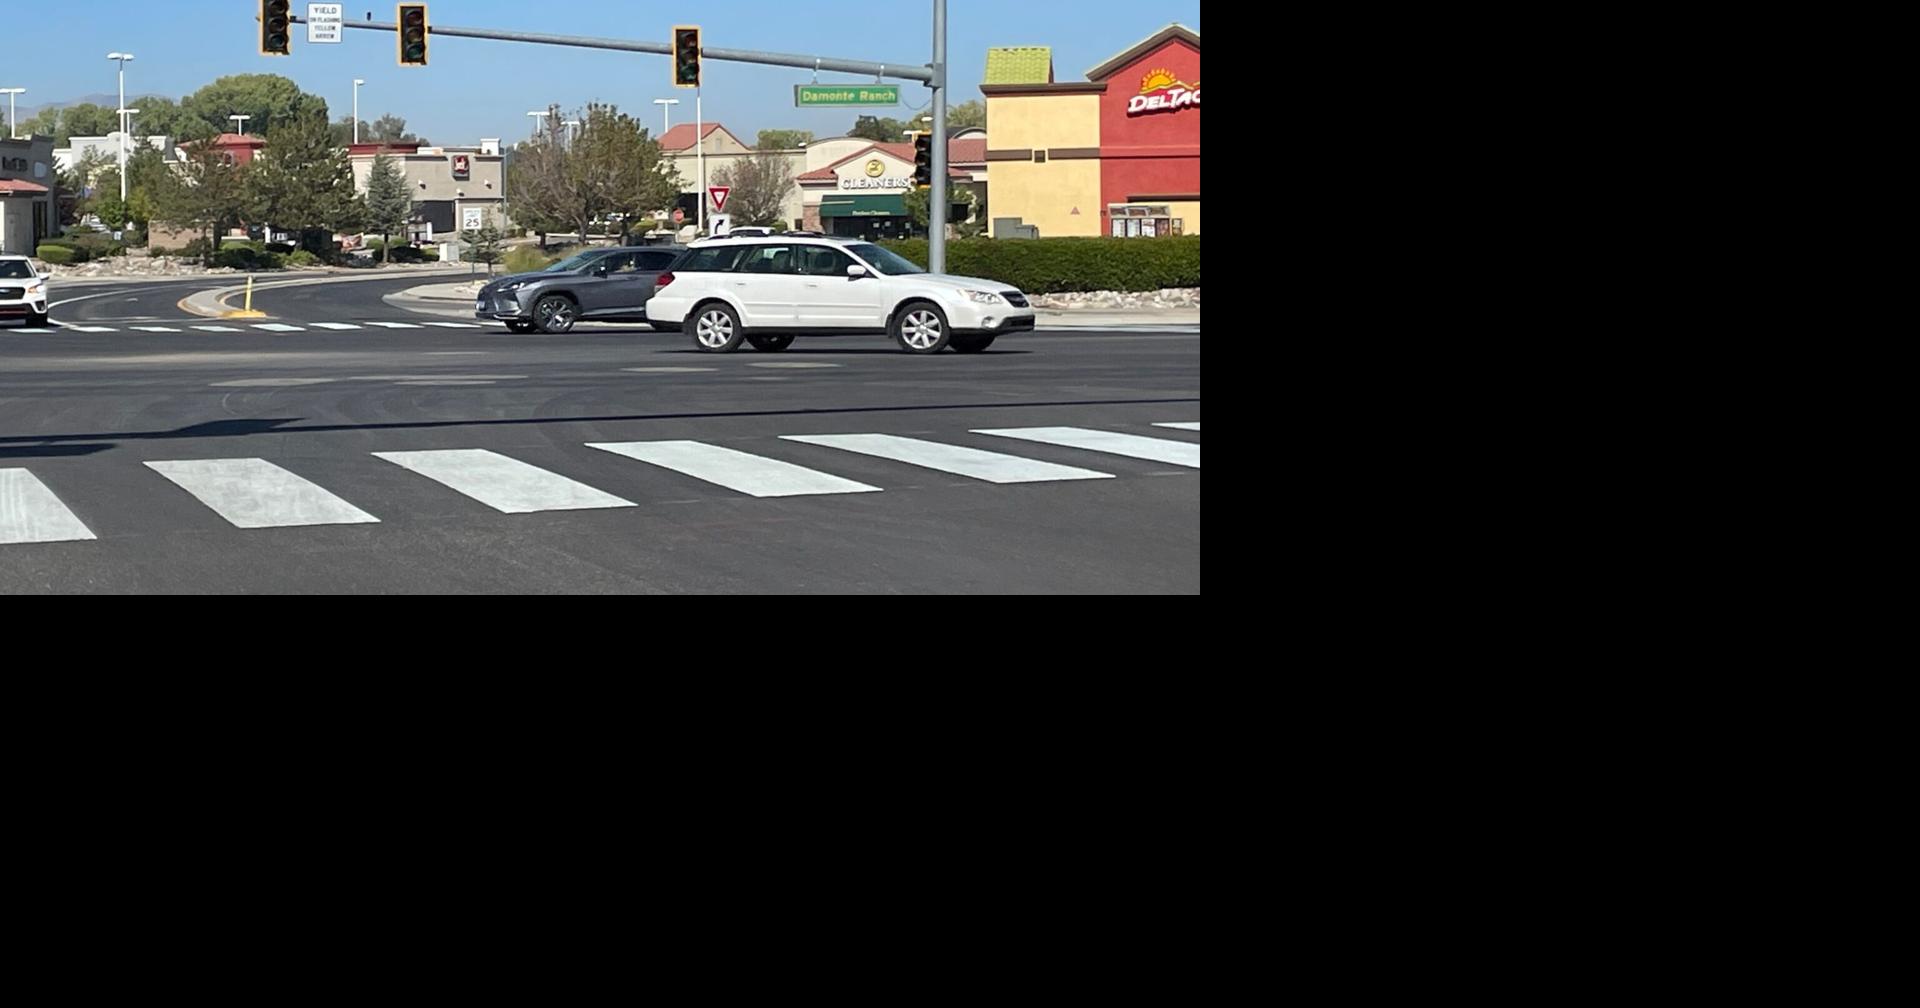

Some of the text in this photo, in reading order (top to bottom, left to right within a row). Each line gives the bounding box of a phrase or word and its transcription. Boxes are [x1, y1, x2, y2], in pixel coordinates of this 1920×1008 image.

[802, 90, 896, 102] Damonte Ranch
[841, 177, 908, 189] CLEANERS
[465, 217, 480, 227] 25
